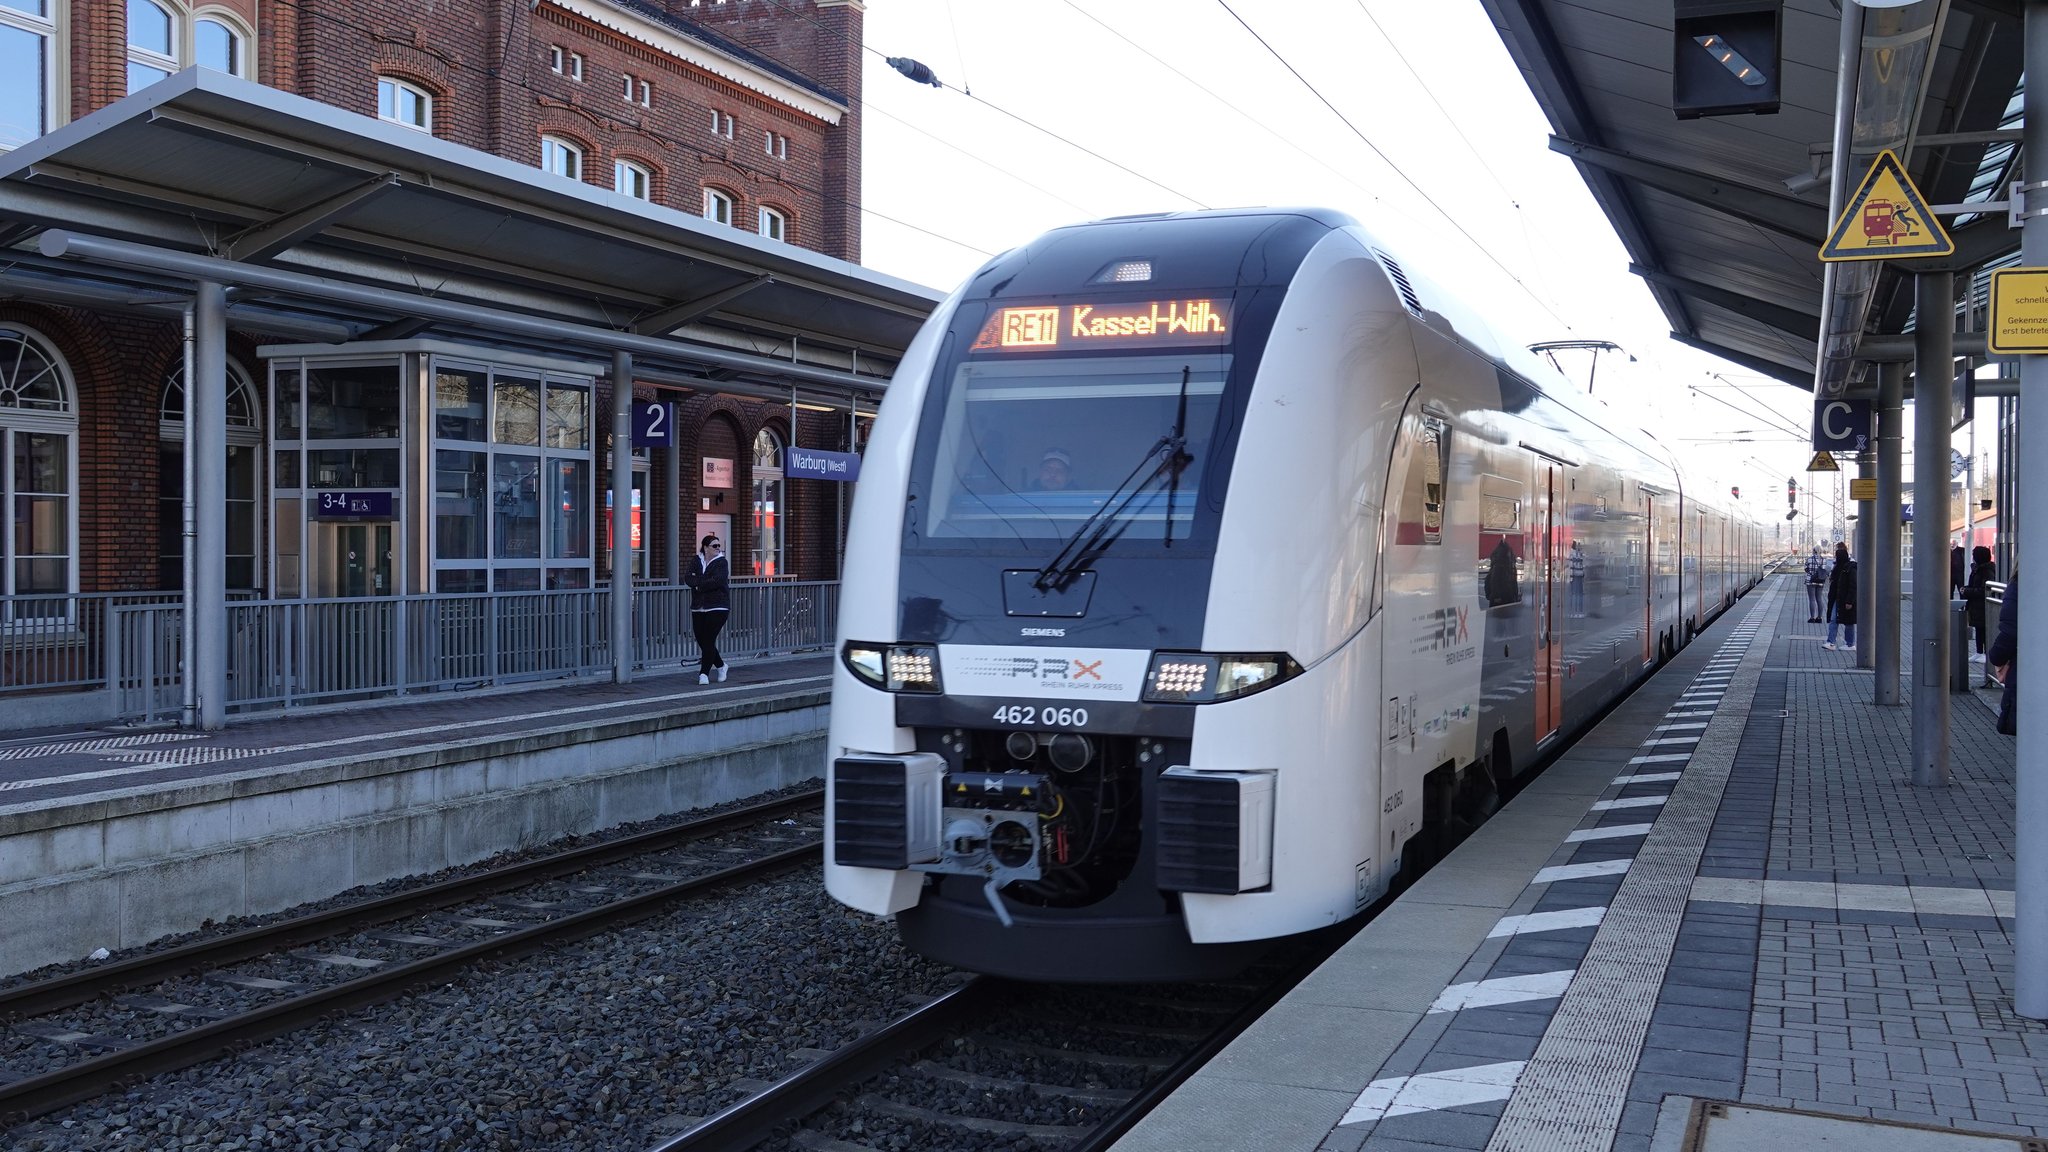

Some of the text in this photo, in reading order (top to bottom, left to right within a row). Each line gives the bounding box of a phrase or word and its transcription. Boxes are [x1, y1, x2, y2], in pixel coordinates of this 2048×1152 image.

[2015, 296, 2048, 304] schnelle
[1005, 301, 1226, 343] RE11 Kassel-Wilh.
[2008, 316, 2048, 325] Gekennze
[646, 403, 665, 437] 2
[1821, 401, 1853, 440] C
[792, 453, 847, 474] Warburg (Westf)
[324, 493, 346, 508] 3-4
[1905, 504, 1914, 516] 4
[1021, 628, 1066, 637] SIEMENS
[1011, 657, 1103, 680] RRX
[1041, 681, 1124, 691] RHEIN RUHR XPRESS
[993, 705, 1088, 726] 462 060
